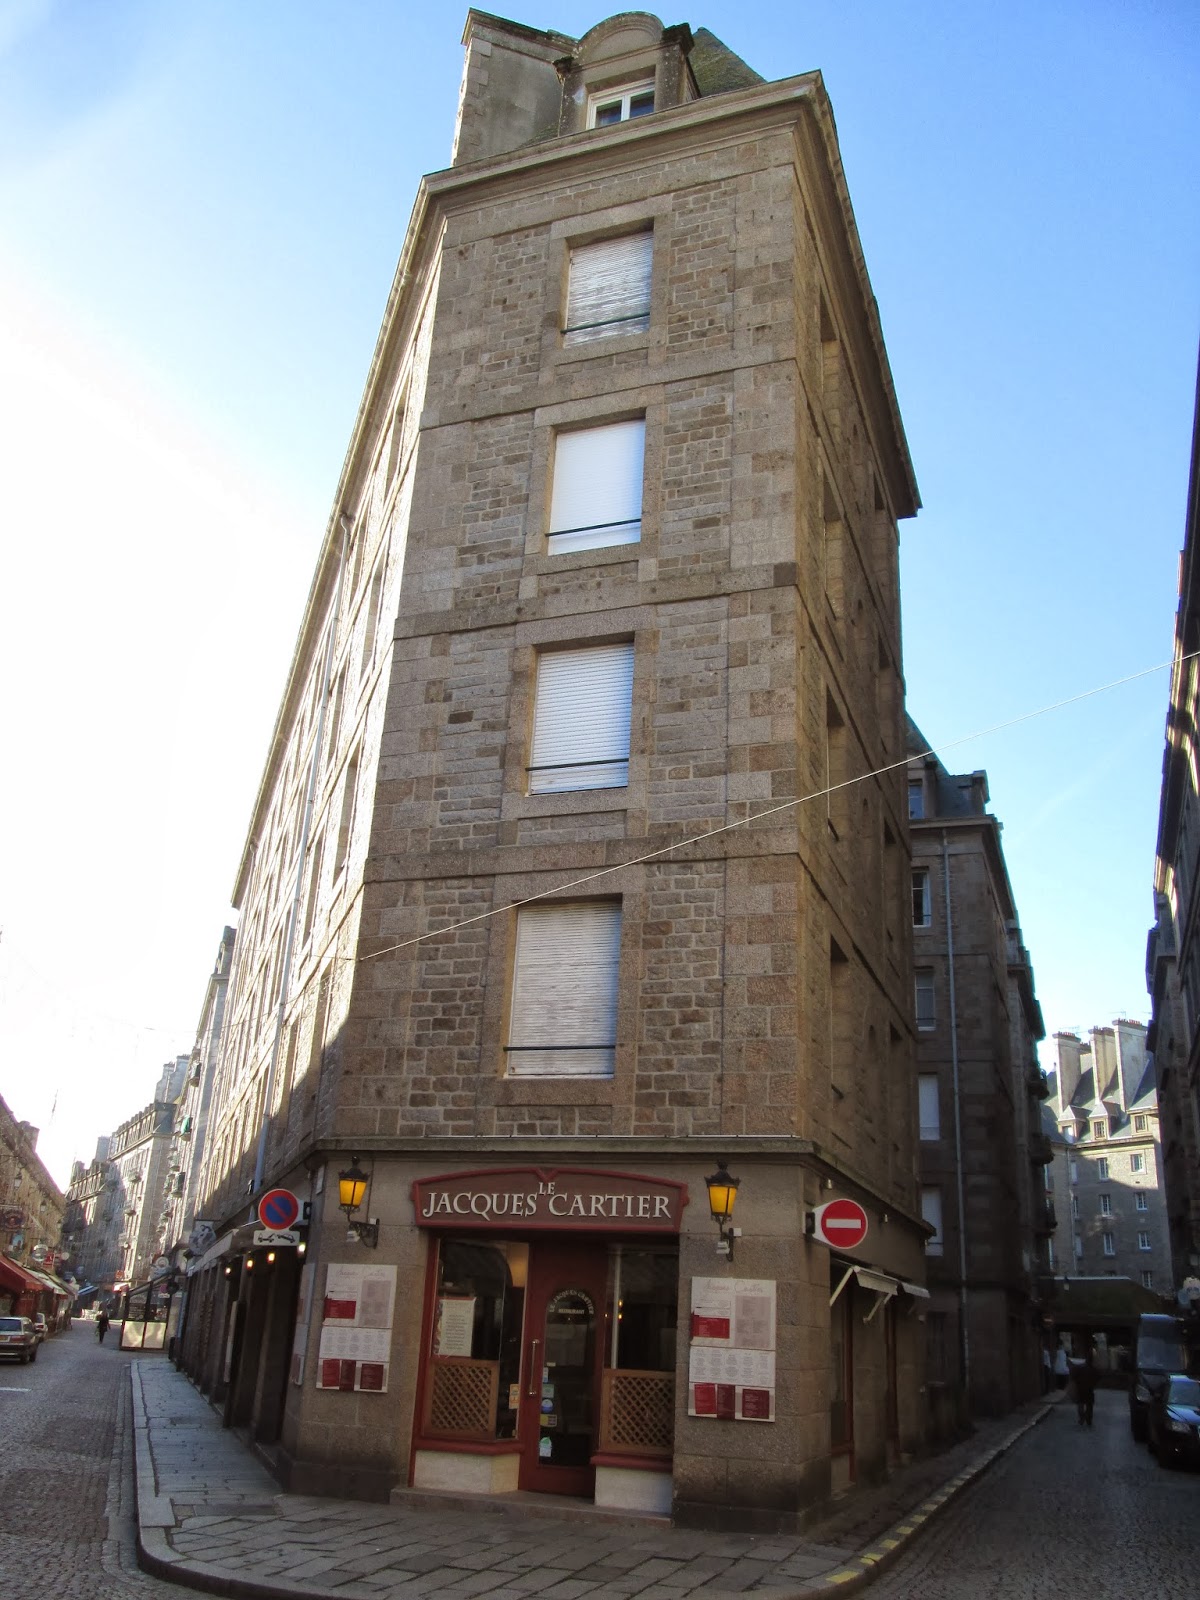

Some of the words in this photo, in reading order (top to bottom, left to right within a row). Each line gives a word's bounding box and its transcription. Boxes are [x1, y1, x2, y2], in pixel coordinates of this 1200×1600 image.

[538, 1181, 556, 1196] LE
[422, 1191, 538, 1221] JACQUES
[548, 1193, 672, 1220] CARTIER
